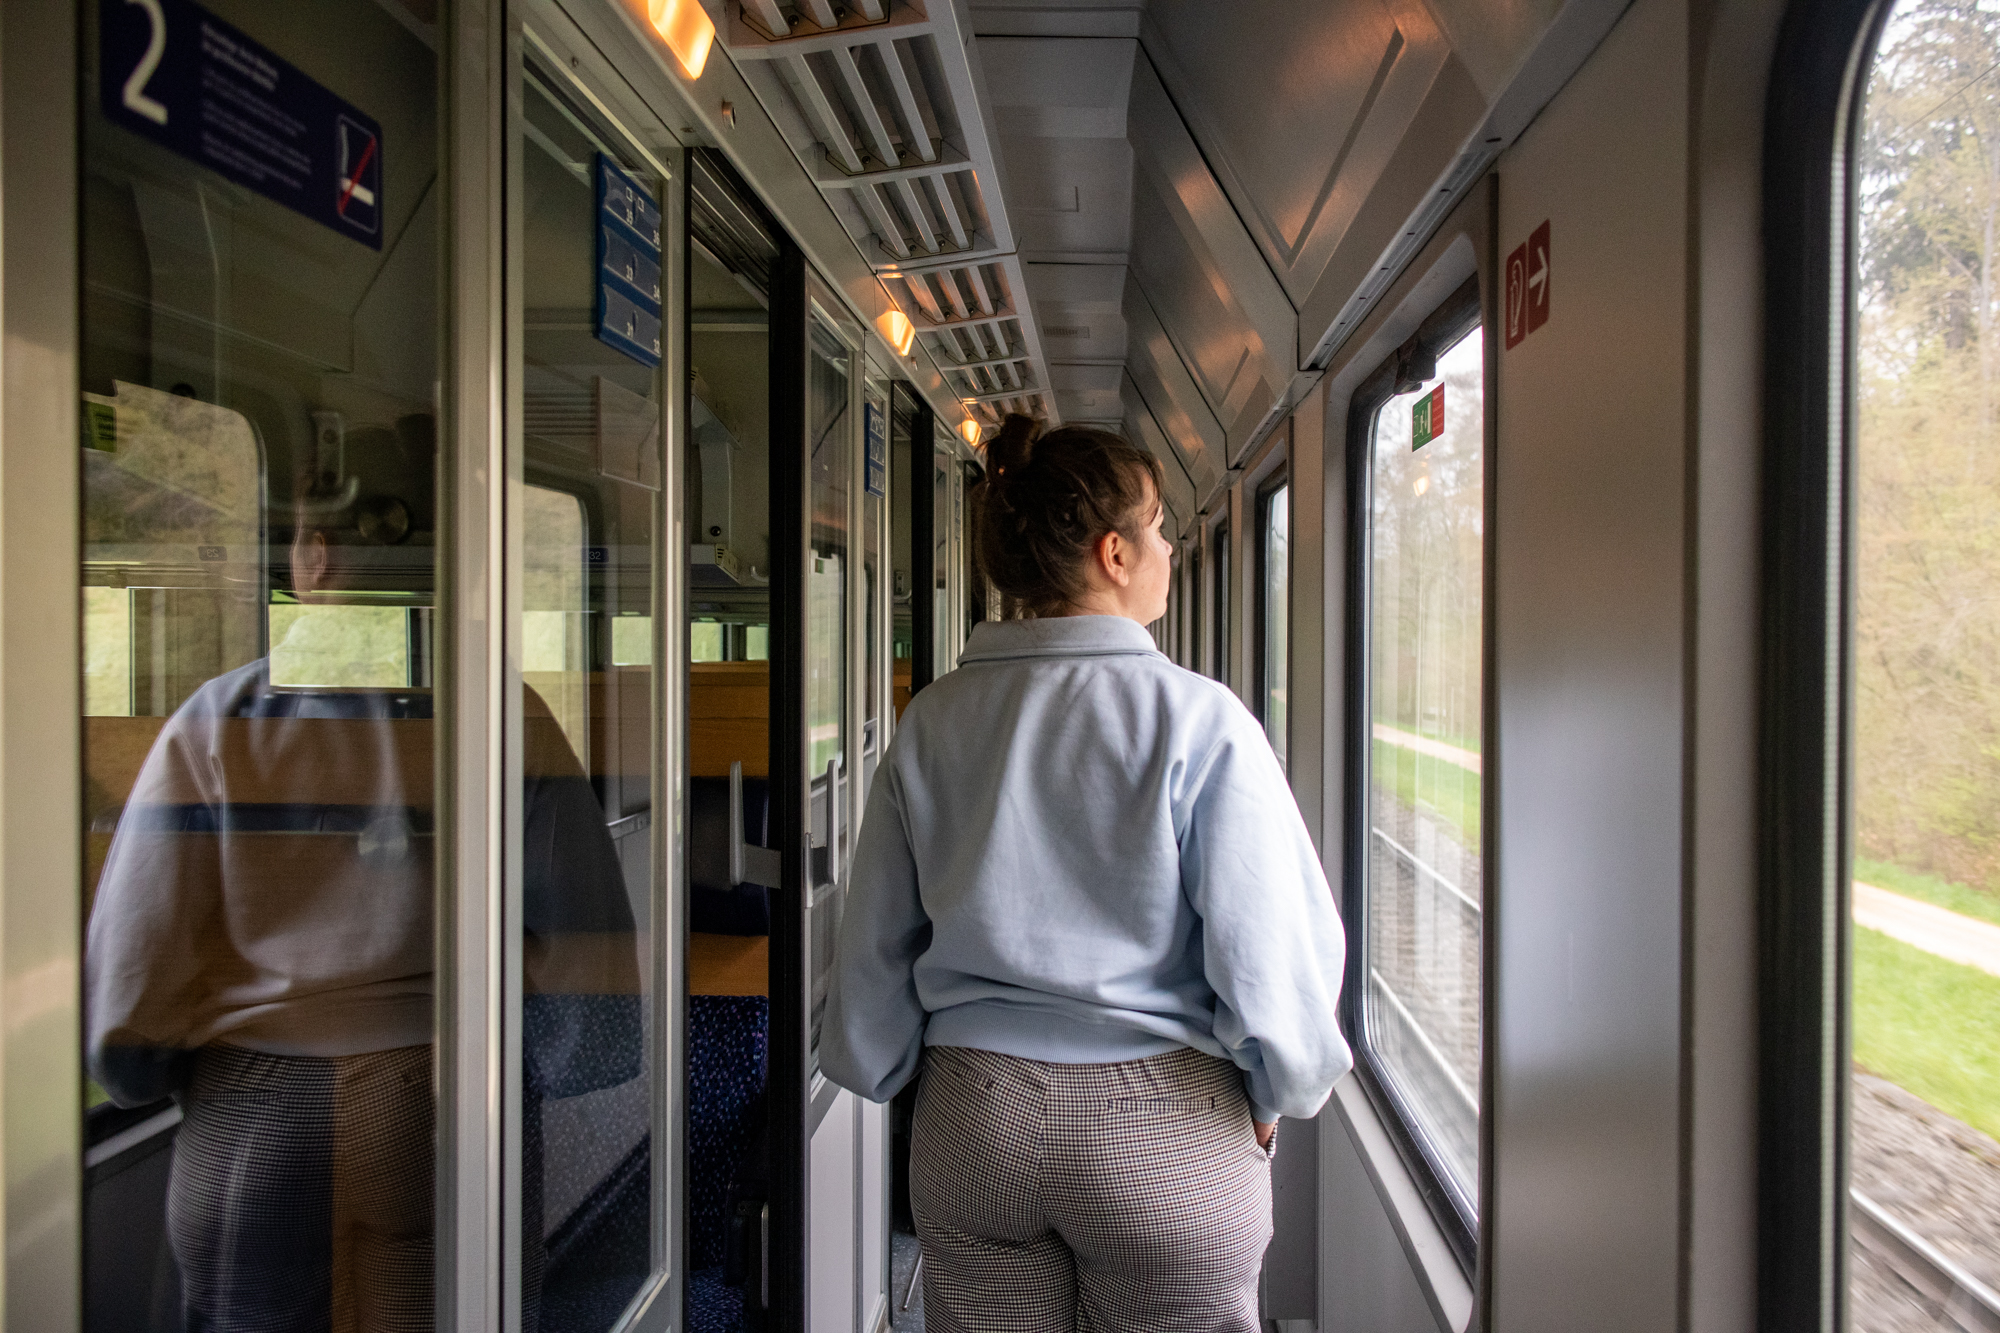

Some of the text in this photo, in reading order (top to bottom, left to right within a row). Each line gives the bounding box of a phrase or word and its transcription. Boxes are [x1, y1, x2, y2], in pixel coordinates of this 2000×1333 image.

[123, 0, 168, 125] 2
[626, 208, 633, 225] 35
[626, 264, 633, 281] 33
[589, 551, 601, 560] 32
